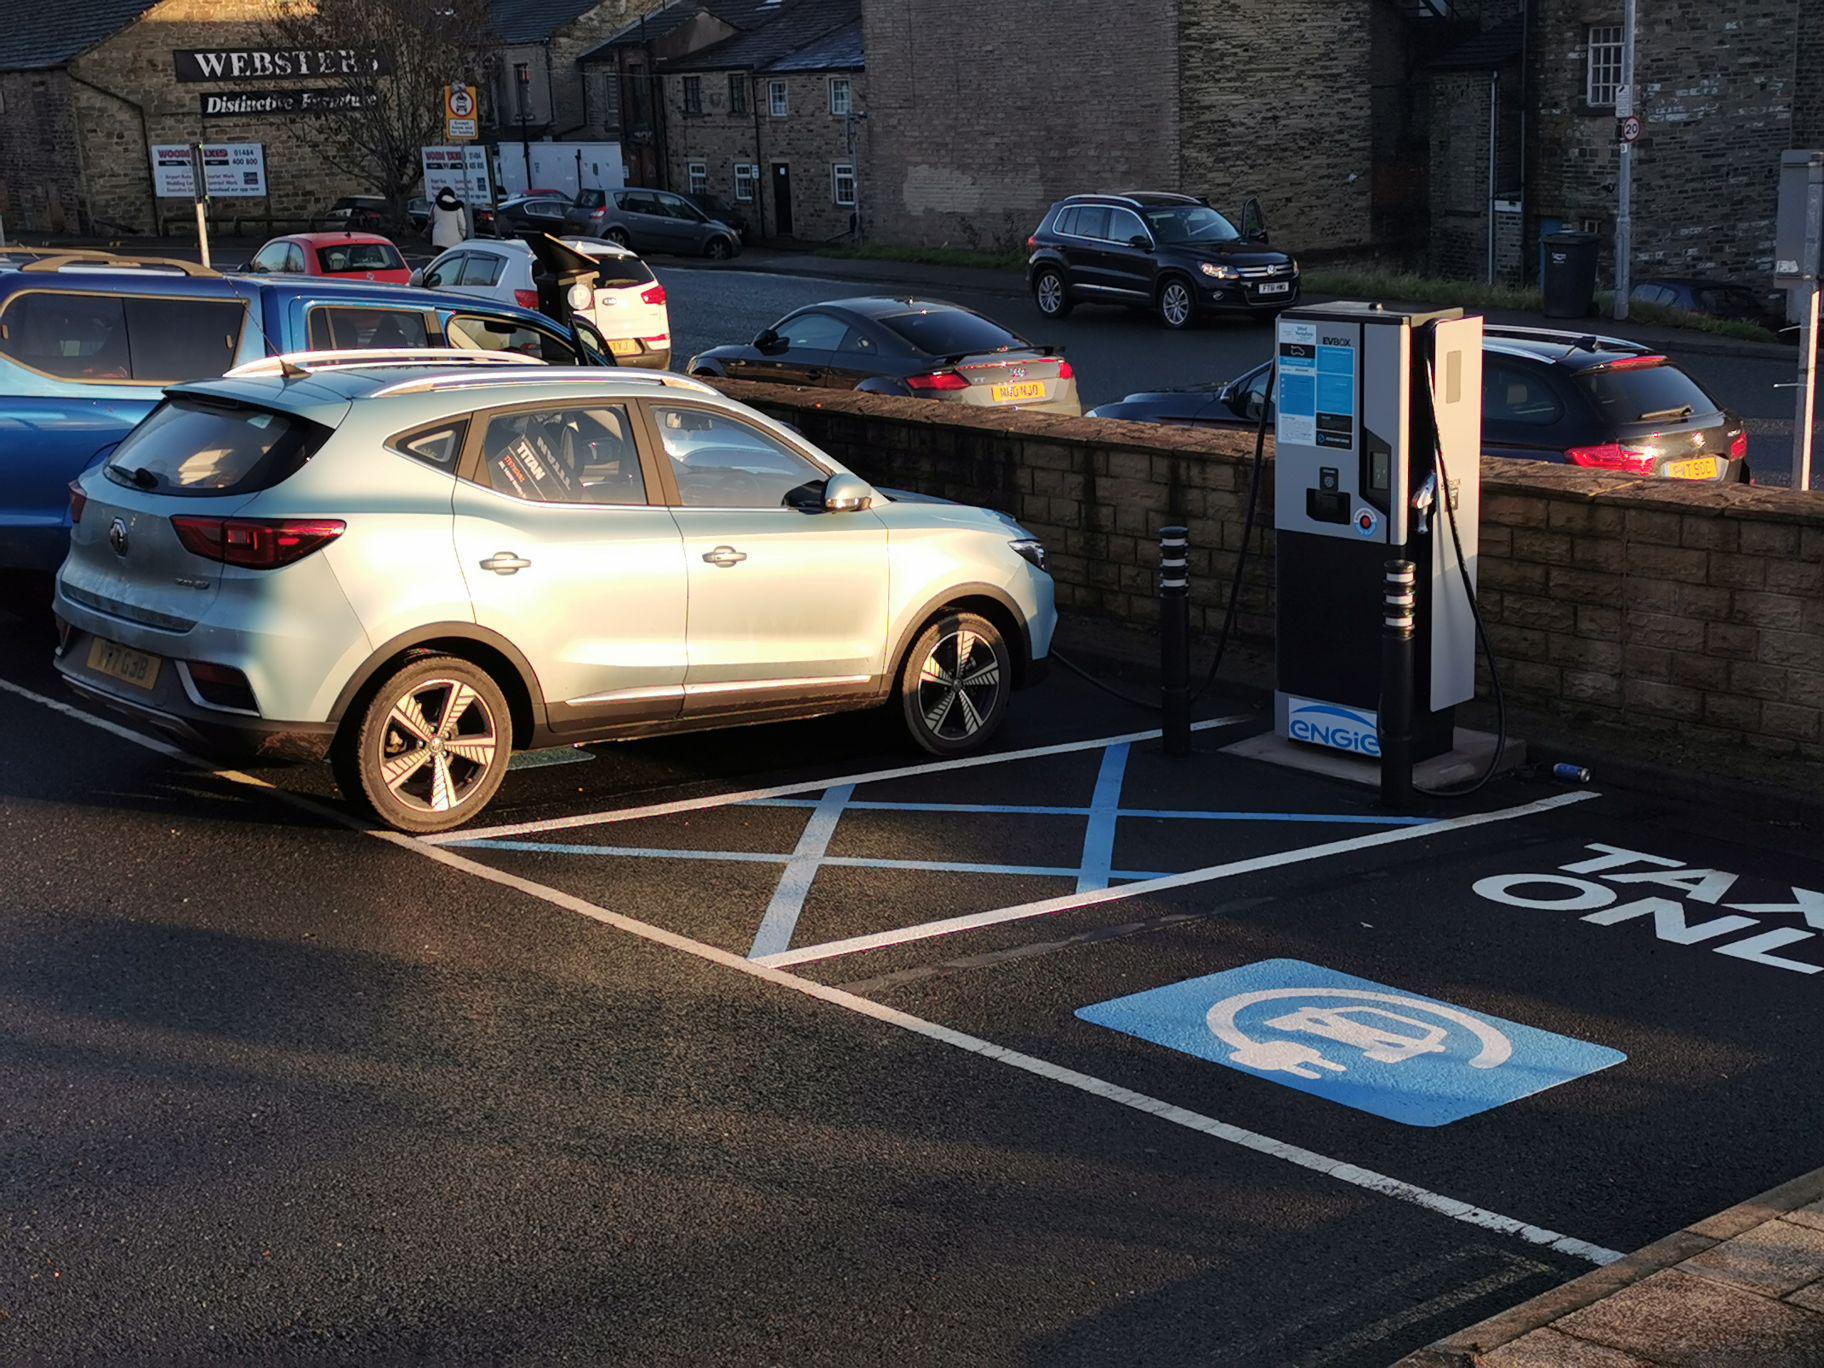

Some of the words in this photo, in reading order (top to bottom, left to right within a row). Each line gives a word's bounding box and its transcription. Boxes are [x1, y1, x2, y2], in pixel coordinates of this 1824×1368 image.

[1626, 123, 1637, 134] 20
[1322, 336, 1351, 346] EVBOX
[517, 441, 546, 480] TITAN
